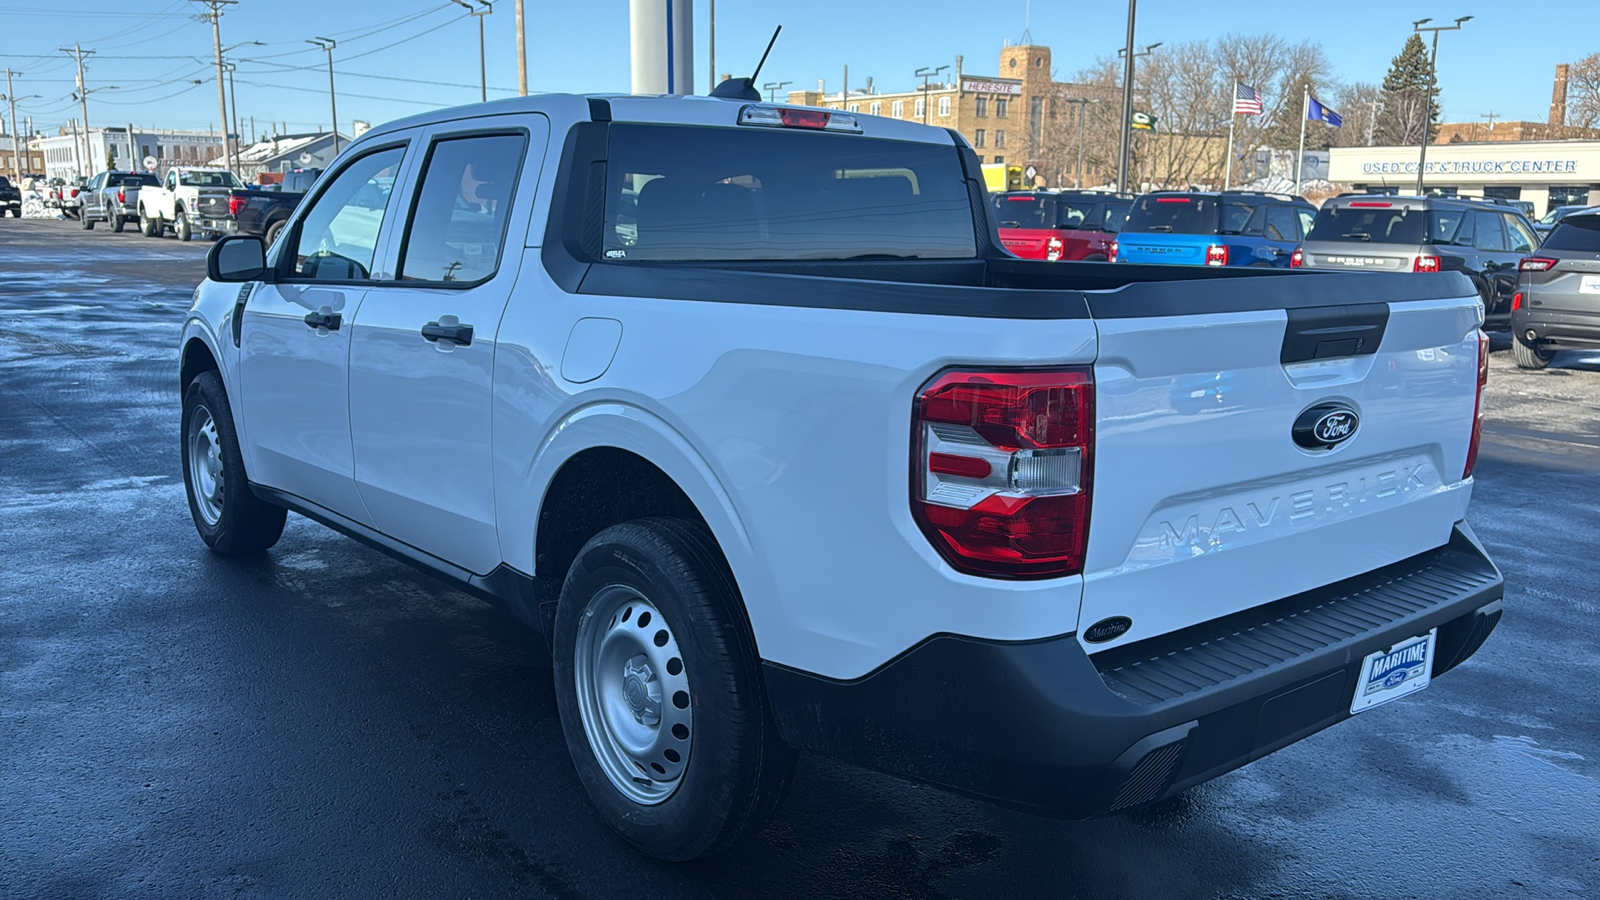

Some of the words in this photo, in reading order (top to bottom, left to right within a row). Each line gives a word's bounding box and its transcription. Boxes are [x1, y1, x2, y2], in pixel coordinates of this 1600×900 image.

[968, 82, 1014, 93] HERESITE
[1363, 162, 1400, 173] USED
[1439, 162, 1448, 172] &
[1453, 161, 1504, 173] TRUCK
[1510, 160, 1577, 172] CENTER
[1323, 415, 1352, 438] Ford
[1159, 463, 1426, 550] MAVERICK
[1370, 641, 1427, 681] MARITIME
